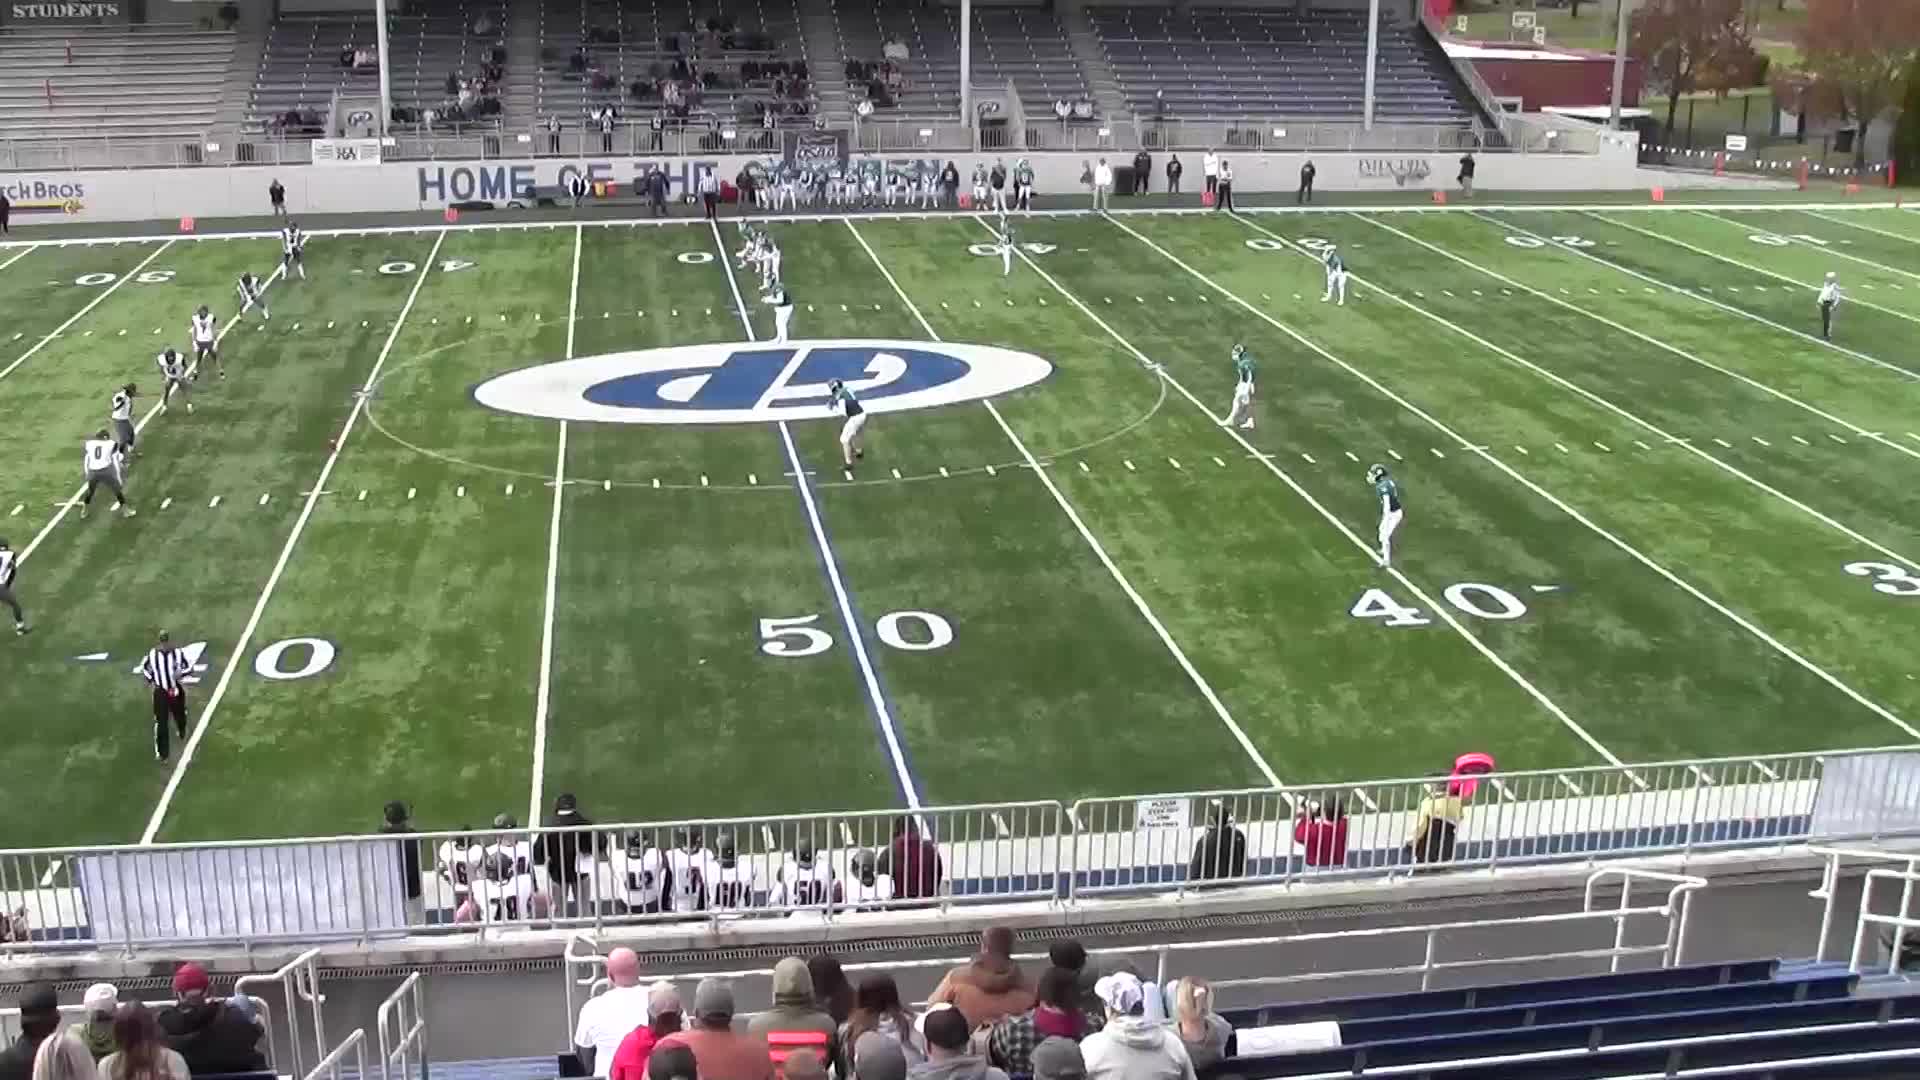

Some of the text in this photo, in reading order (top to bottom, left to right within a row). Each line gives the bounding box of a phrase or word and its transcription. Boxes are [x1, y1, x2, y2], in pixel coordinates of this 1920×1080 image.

[13, 3, 119, 17] STUDENTS
[417, 165, 536, 201] HOME
[1350, 581, 1528, 627] 40
[759, 610, 954, 657] 50
